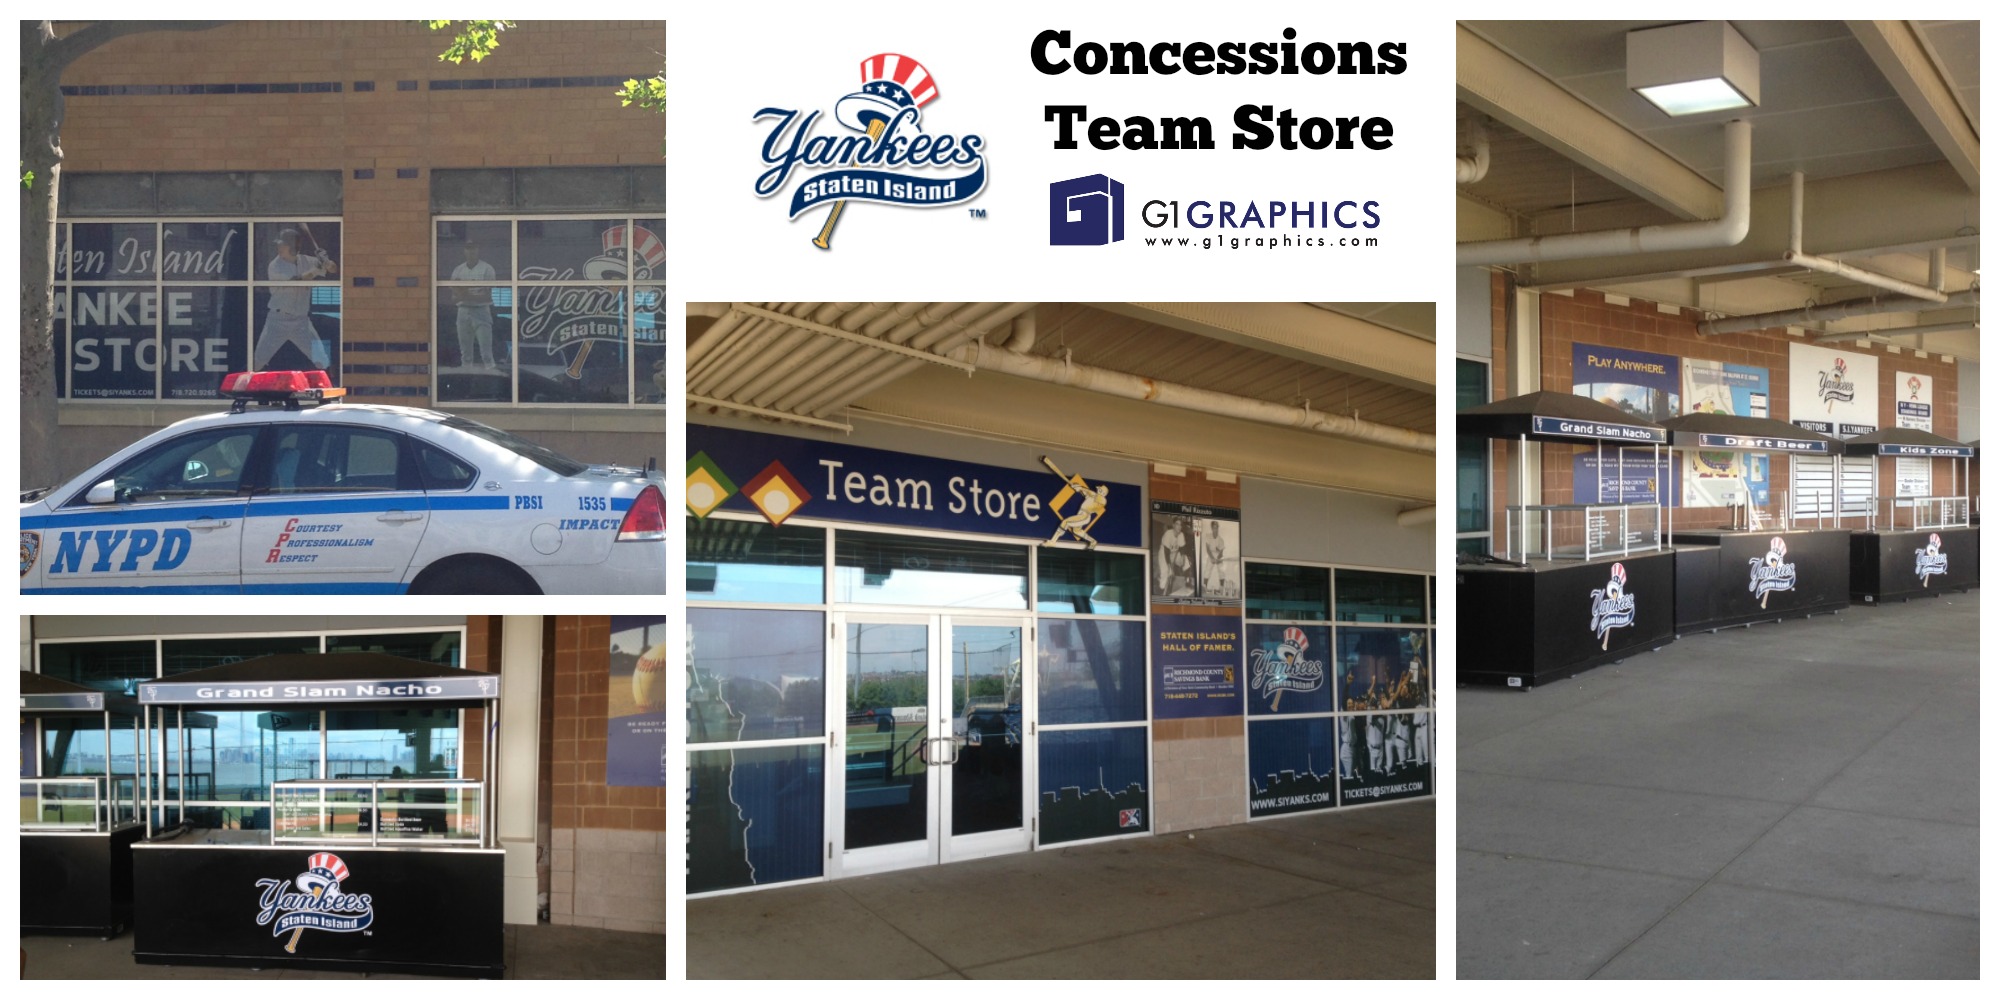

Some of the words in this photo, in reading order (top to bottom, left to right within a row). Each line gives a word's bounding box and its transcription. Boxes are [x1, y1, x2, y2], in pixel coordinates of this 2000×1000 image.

[56, 241, 105, 275] ten
[53, 291, 194, 327] ANKEE
[560, 321, 618, 342] Staten
[622, 325, 666, 341] Islan
[73, 337, 230, 373] STORE
[1588, 354, 1612, 368] PLAY
[1614, 358, 1666, 375] ANYWHERE.
[1560, 422, 1593, 434] Grand
[1596, 426, 1620, 437] Slam
[1622, 428, 1651, 439] Nacho
[1800, 421, 1827, 432] VISITORS
[1725, 437, 1772, 447] Draft
[1777, 440, 1812, 449] Beer
[1900, 446, 1926, 454] Kids
[1930, 447, 1959, 455] Zone
[818, 458, 934, 511] Team
[947, 476, 1041, 522] Store
[514, 495, 544, 510] PBSI
[578, 496, 606, 511] 1535
[284, 517, 343, 533] COURTESY
[558, 518, 621, 531] IMPACT
[274, 533, 375, 548] PROFESSIONALISM
[48, 527, 193, 574] NYPD
[265, 549, 319, 563] RESPECT
[1160, 632, 1194, 640] STATEN
[1196, 632, 1236, 640] ISLAND'S
[1162, 644, 1187, 652] HALL
[1189, 644, 1201, 652] OF
[1250, 649, 1323, 690] Yankees
[196, 686, 274, 700] Grand
[283, 684, 347, 698] Slam
[356, 683, 443, 697] Nacho
[1344, 781, 1424, 799] TICKETS@SIYANKS.COM
[1251, 792, 1330, 811] WWW.SIYANKS.COM
[255, 877, 373, 926] Yankees
[281, 913, 319, 928] Staten
[321, 916, 358, 929] Island
